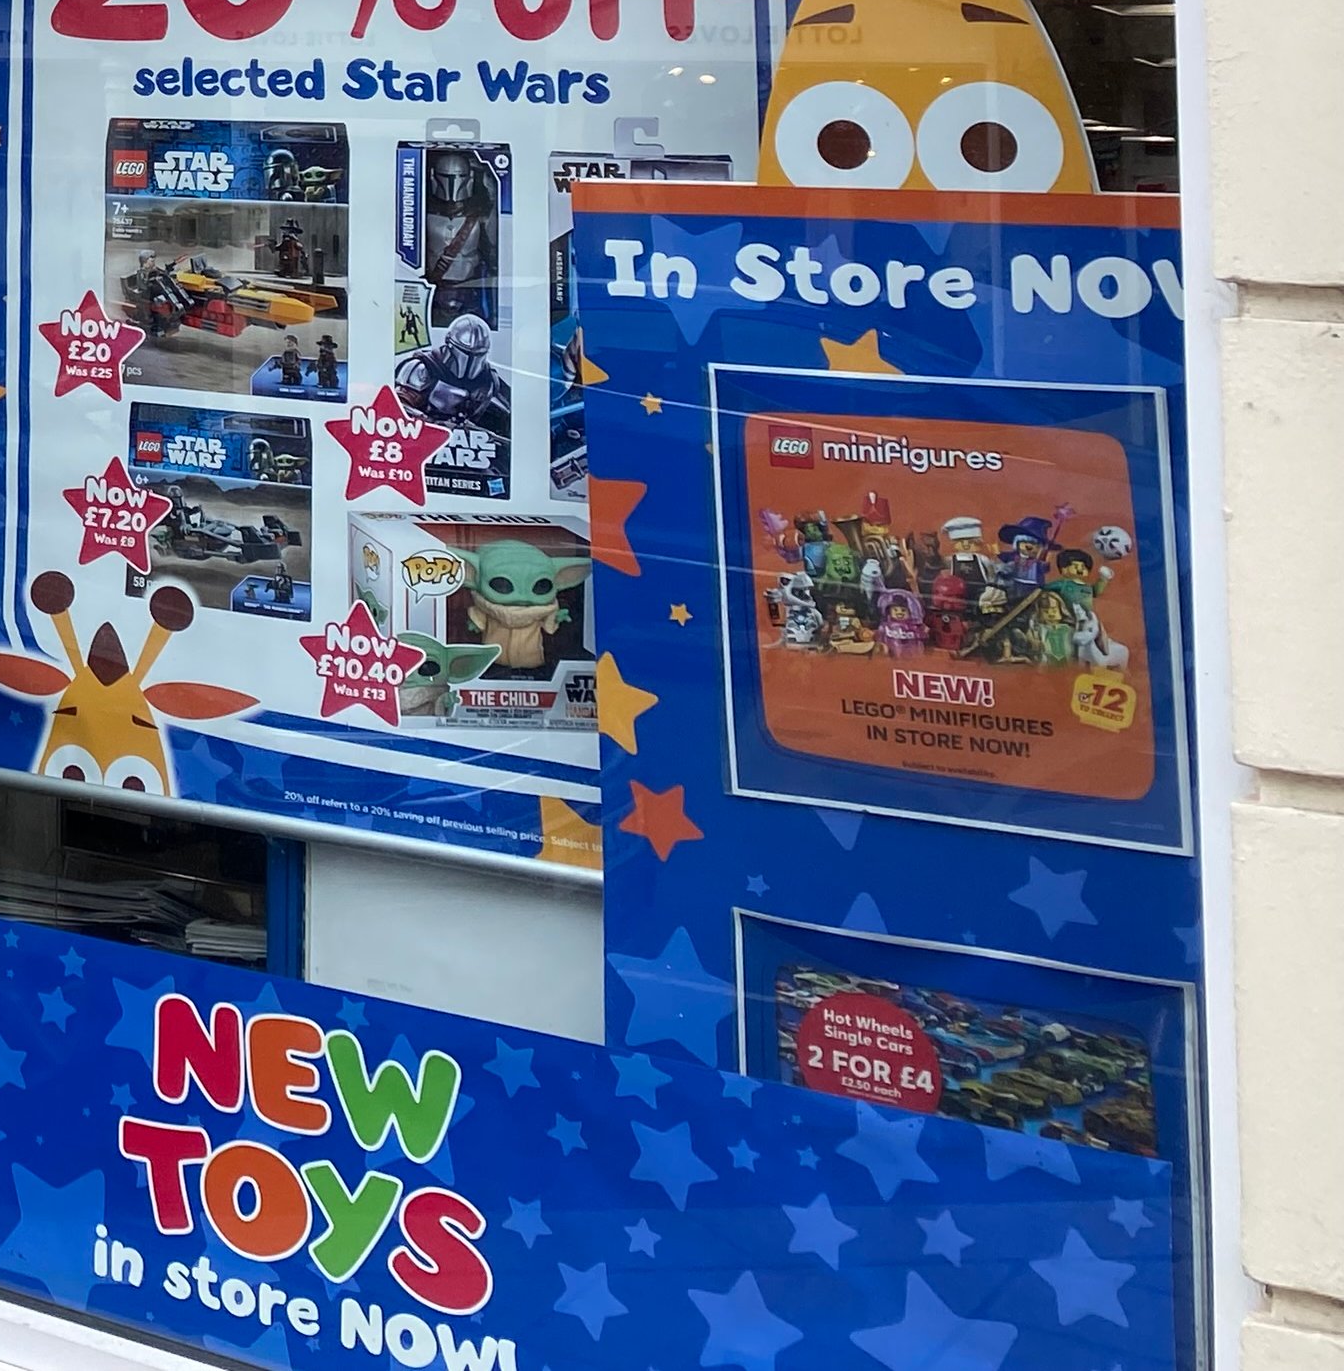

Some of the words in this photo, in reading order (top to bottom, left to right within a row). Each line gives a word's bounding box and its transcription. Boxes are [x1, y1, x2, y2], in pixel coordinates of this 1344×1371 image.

[133, 57, 326, 103] selected
[342, 59, 460, 103] Star
[477, 60, 610, 105] Wars
[116, 159, 146, 176] LEGO
[154, 151, 235, 171] STAR
[403, 157, 414, 175] THE
[553, 162, 626, 179] STAR
[154, 170, 235, 192] WARS
[402, 176, 414, 247] MANDALORIAN
[603, 238, 699, 300] In
[729, 242, 979, 311] Store
[61, 309, 121, 340] Now
[68, 341, 111, 363] £20
[65, 364, 88, 378] Was
[90, 366, 113, 380] £25
[350, 406, 424, 441] Now
[137, 440, 161, 453] LEGO
[167, 435, 226, 454] STAR
[167, 450, 227, 470] WARS
[368, 440, 403, 464] £8
[772, 437, 810, 456] LEGO
[823, 434, 1003, 474] minifigures
[358, 466, 385, 479] Was
[387, 467, 413, 481] £10
[452, 478, 481, 490] SERIES
[84, 476, 147, 509] Now
[84, 506, 147, 533] £7.20
[412, 513, 461, 523] THE
[472, 514, 552, 524] CHILD
[94, 533, 117, 546] Was
[401, 556, 463, 587] POP!
[326, 623, 398, 659] Now
[317, 653, 404, 685] £10.40
[333, 682, 360, 698] Was
[363, 687, 386, 701] £13
[469, 691, 494, 706] THE
[500, 692, 540, 707] CHILD
[892, 669, 996, 708] NEW!
[1093, 684, 1128, 713] 12
[910, 706, 1054, 737] MINIFIGURES
[866, 724, 888, 742] IN
[895, 729, 963, 751] STORE
[970, 737, 1031, 758] NOW!
[284, 790, 304, 802] 20%
[306, 795, 320, 806] off
[321, 798, 348, 810] refers
[350, 802, 360, 812] to
[371, 805, 391, 817] 20%
[393, 810, 424, 824] saving
[426, 815, 440, 825] off
[442, 819, 483, 833] previous
[486, 825, 517, 840] selling
[551, 836, 590, 850] Subject
[823, 1008, 852, 1027] Hot
[855, 1015, 914, 1040] Wheels
[824, 1025, 872, 1047] Single
[876, 1037, 914, 1056] Cars
[153, 992, 463, 1164] NEW
[808, 1045, 824, 1069] 2
[832, 1049, 892, 1085] FOR
[900, 1066, 935, 1094] £4
[841, 1076, 871, 1091] £2.50
[874, 1085, 902, 1098] each
[118, 1115, 495, 1317] TOYS
[92, 1223, 145, 1288] in
[163, 1256, 322, 1337] store
